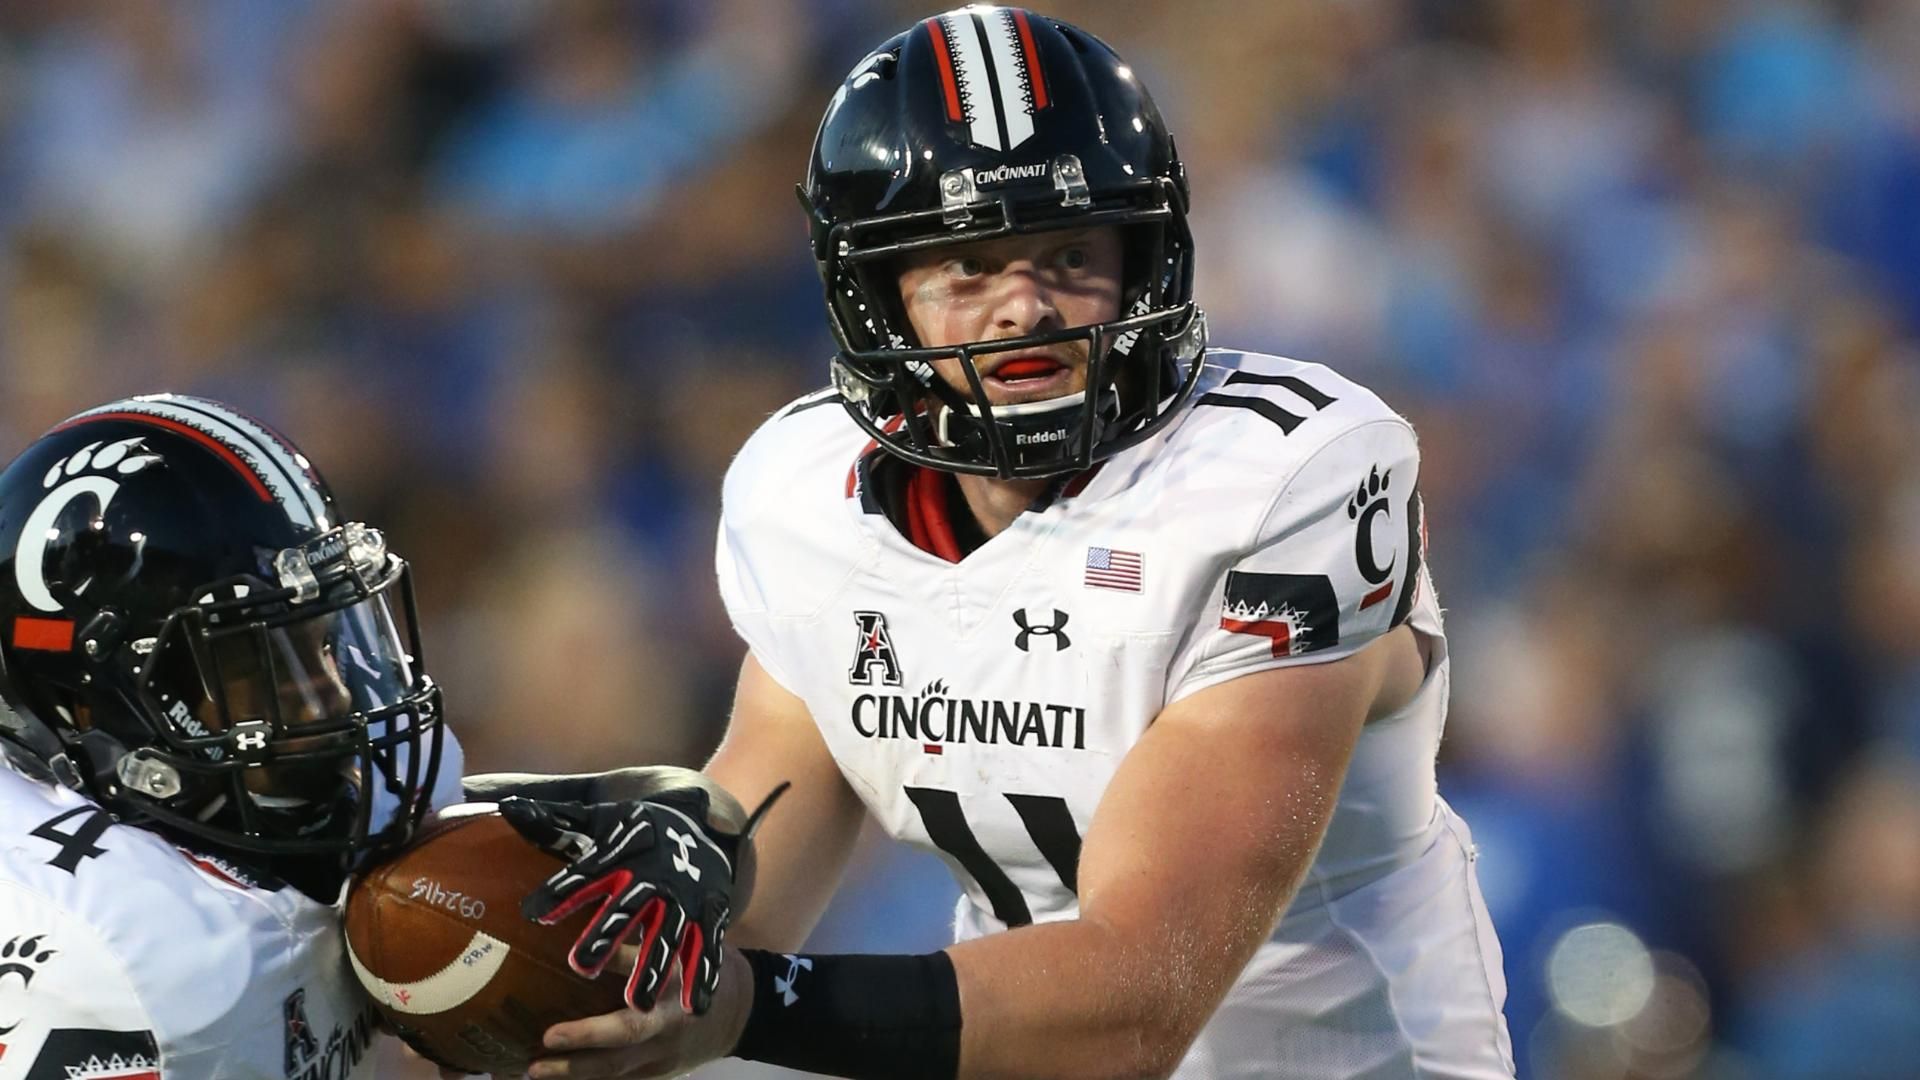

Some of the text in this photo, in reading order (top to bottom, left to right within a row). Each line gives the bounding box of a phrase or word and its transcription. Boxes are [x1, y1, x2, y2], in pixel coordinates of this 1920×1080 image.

[976, 164, 1046, 184] CINCINNATI
[1016, 429, 1066, 445] Riddell
[1193, 370, 1339, 436] 11
[15, 475, 120, 613] C
[1356, 497, 1397, 585] C
[849, 610, 904, 688] A
[851, 692, 1087, 750] CINCINNATI
[29, 804, 114, 877] 4
[903, 785, 1083, 930] 11
